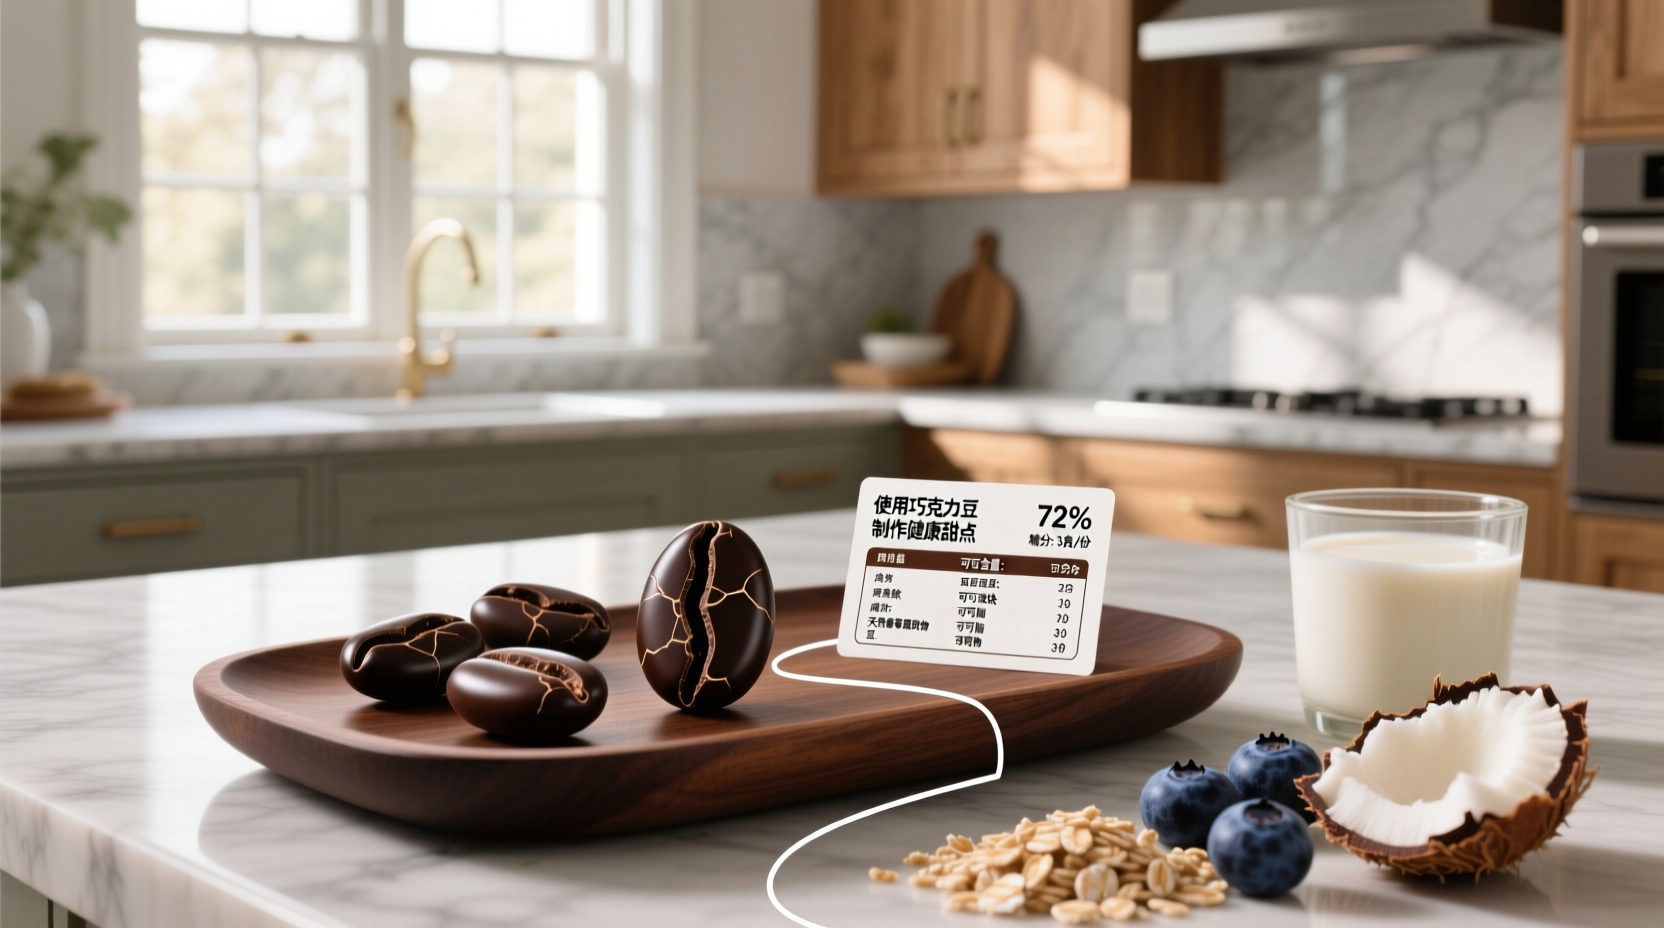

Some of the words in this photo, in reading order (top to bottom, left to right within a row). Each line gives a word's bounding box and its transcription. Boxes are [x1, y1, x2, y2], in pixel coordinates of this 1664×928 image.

[874, 495, 979, 518] 使用巧克力豆
[1038, 504, 1092, 530] 72%
[872, 518, 977, 543] 制作健康甜点
